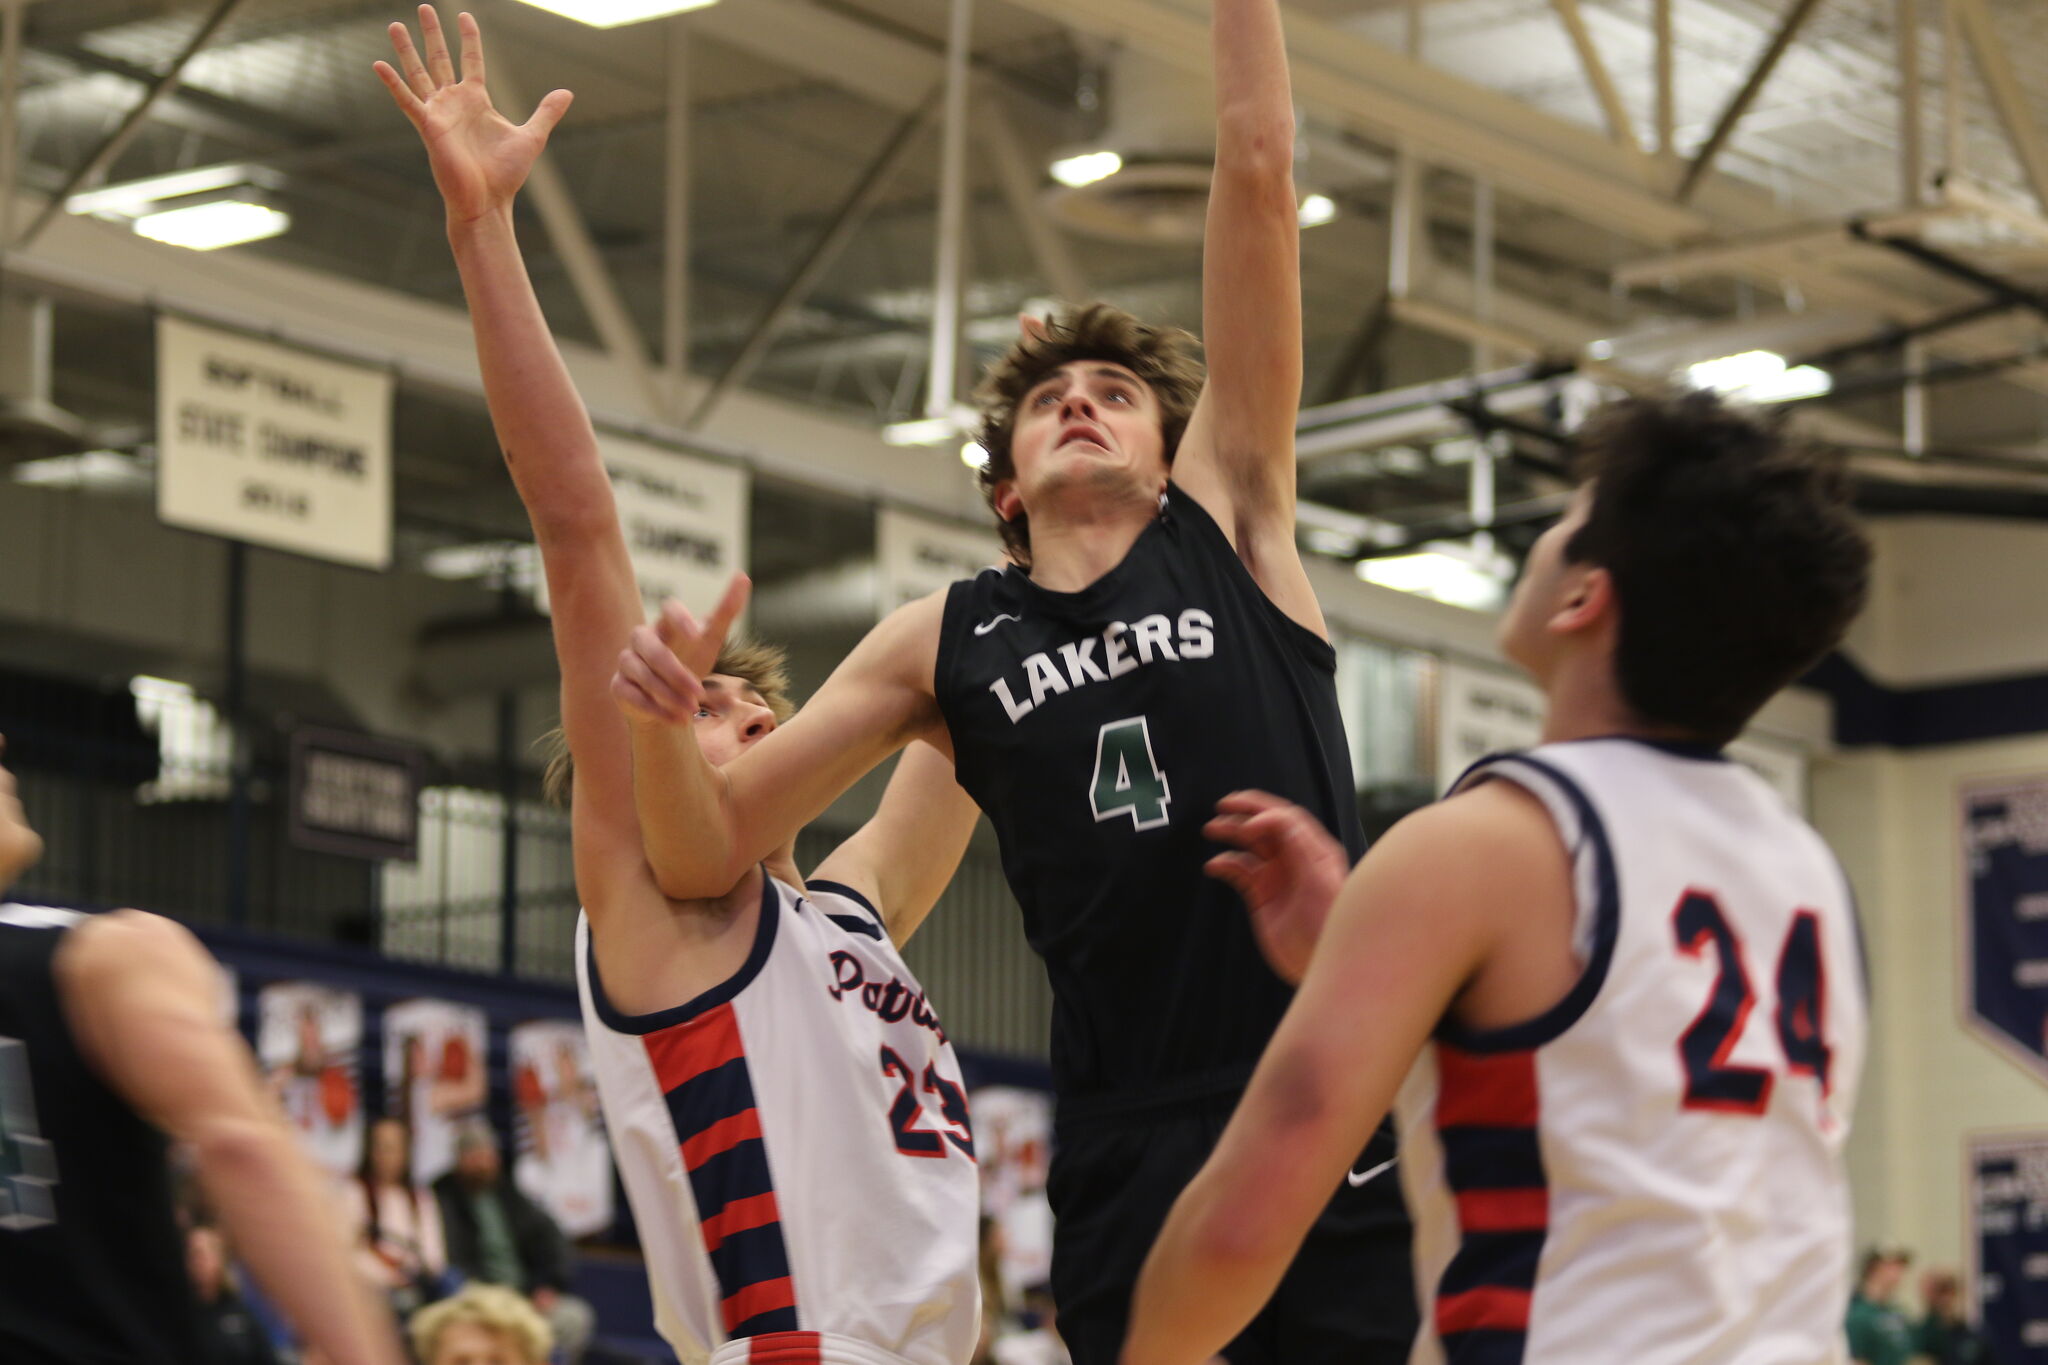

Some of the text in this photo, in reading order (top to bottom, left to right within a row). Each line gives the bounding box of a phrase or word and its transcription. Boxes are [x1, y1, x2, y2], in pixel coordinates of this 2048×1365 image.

[989, 608, 1215, 725] LAKERS
[1089, 715, 1171, 832] 4
[1671, 885, 1834, 1117] 24
